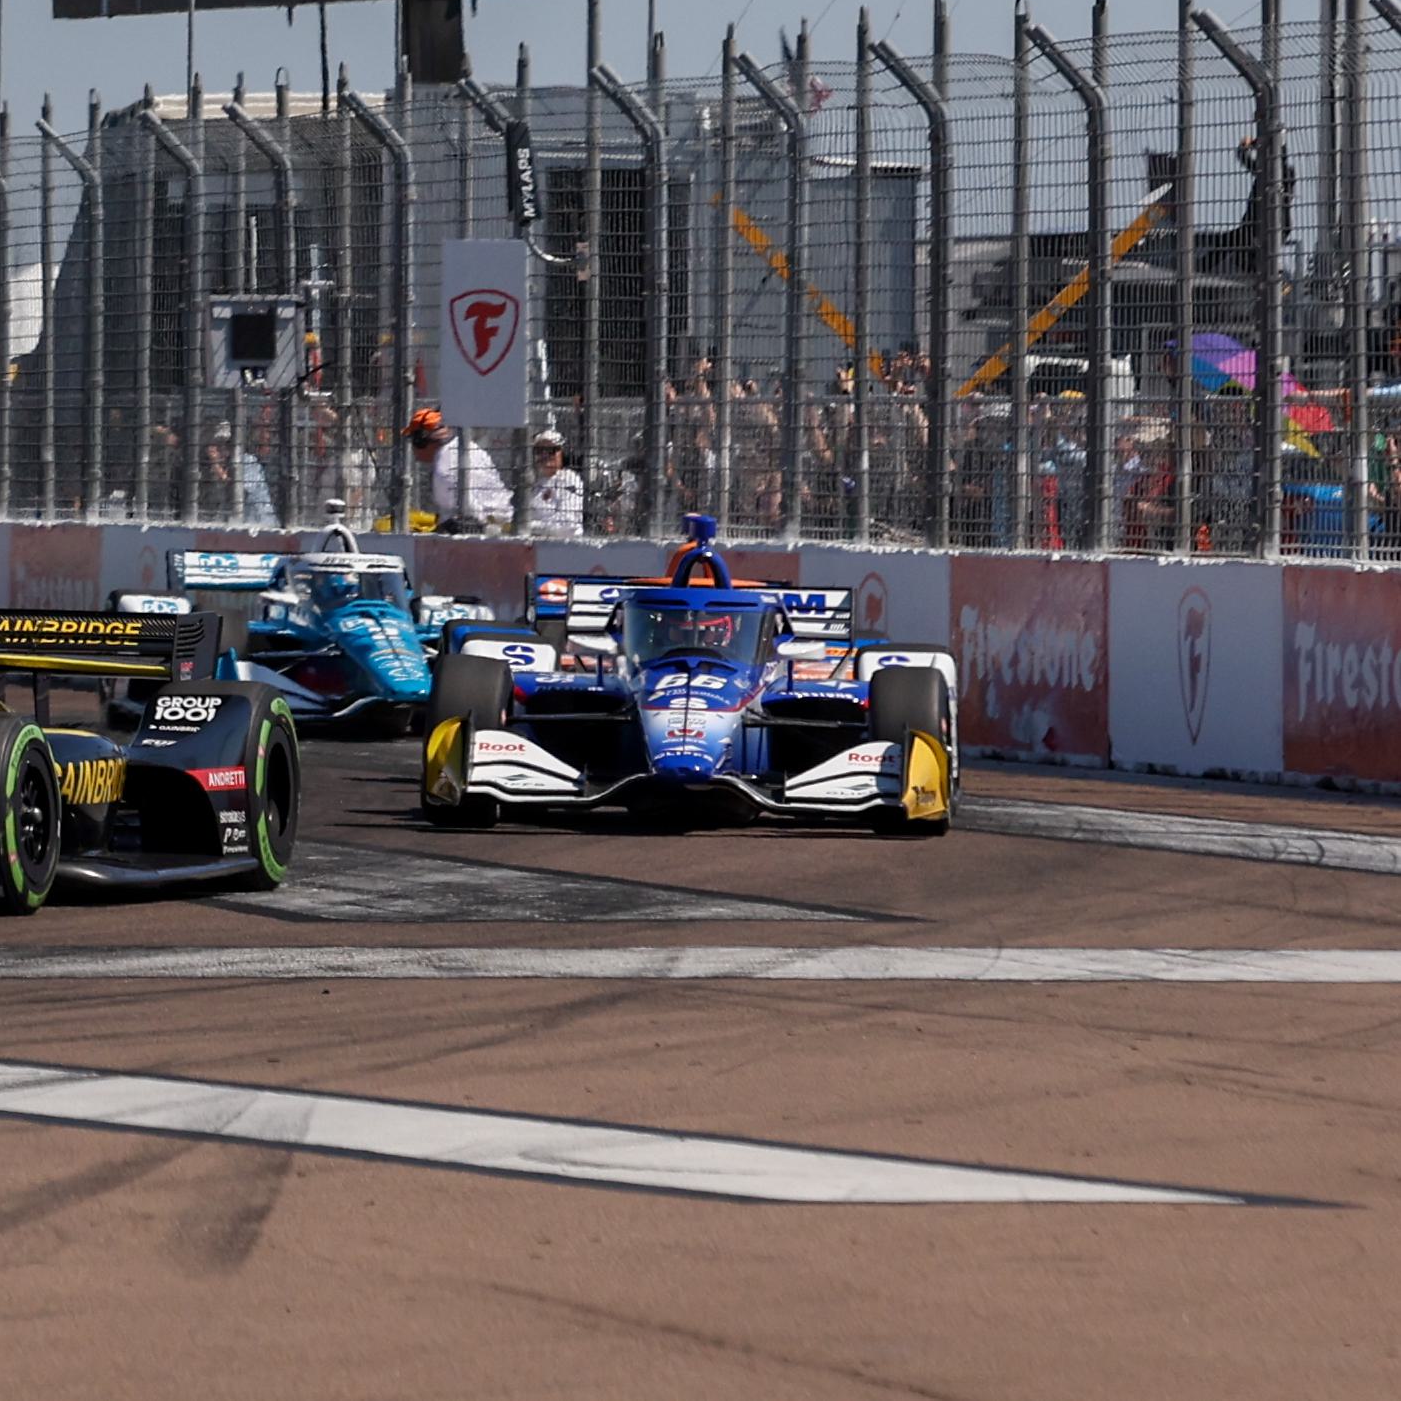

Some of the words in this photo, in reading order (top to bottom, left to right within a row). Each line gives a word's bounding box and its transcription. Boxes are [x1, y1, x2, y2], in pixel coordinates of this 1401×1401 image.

[517, 148, 536, 217] MYLAPS
[959, 606, 1097, 697] Firestone
[655, 673, 727, 689] 66
[157, 696, 222, 708] GROUP
[154, 707, 216, 722] 1001
[479, 742, 526, 752] Root
[848, 752, 895, 763] Root
[208, 770, 245, 787] ANDRETTI
